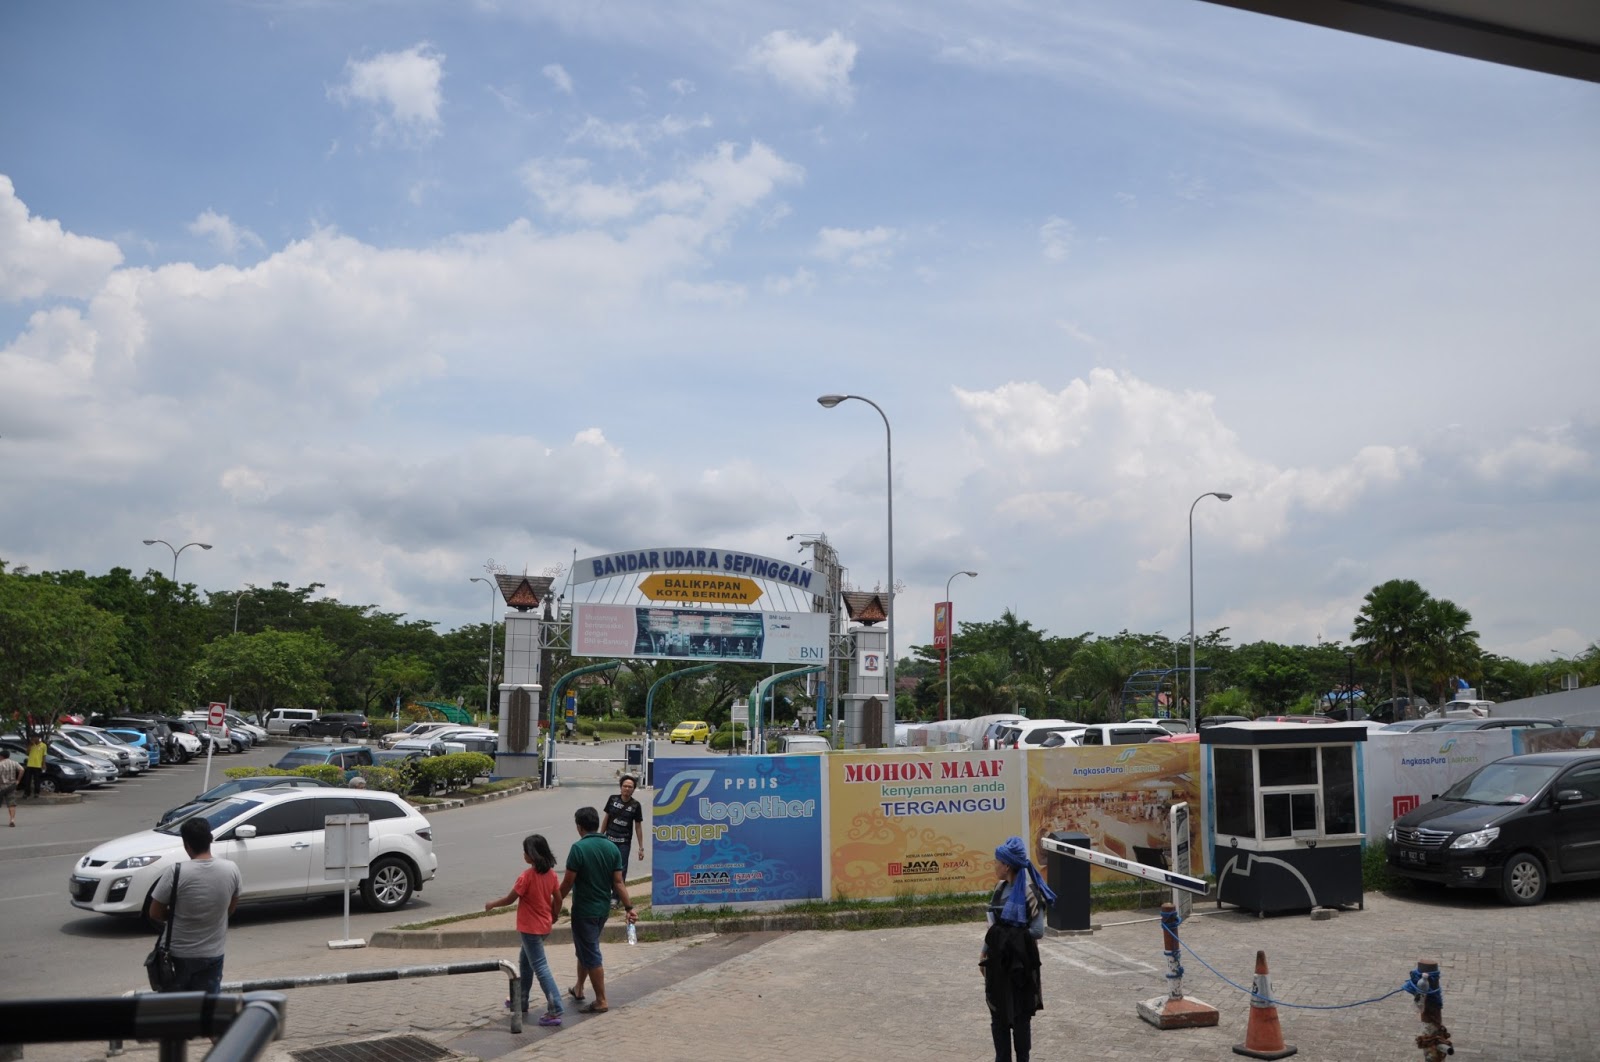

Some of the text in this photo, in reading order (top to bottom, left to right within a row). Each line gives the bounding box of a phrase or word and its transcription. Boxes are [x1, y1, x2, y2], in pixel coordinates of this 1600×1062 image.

[593, 550, 812, 588] BANDAR UDARA SEPINGGAN
[664, 579, 741, 591] BALIKPAPAN
[656, 590, 748, 600] KOTA BERIMAN
[935, 635, 946, 645] CFC
[800, 647, 823, 659] BNI
[844, 760, 1004, 783] MOHON MAAF
[724, 777, 778, 789] PPBIS
[881, 781, 1005, 798] kenyamanan anda
[699, 796, 815, 825] together
[881, 798, 1006, 816] TERGANGGU
[902, 861, 939, 869] JAYA
[692, 872, 729, 880] JAYA
